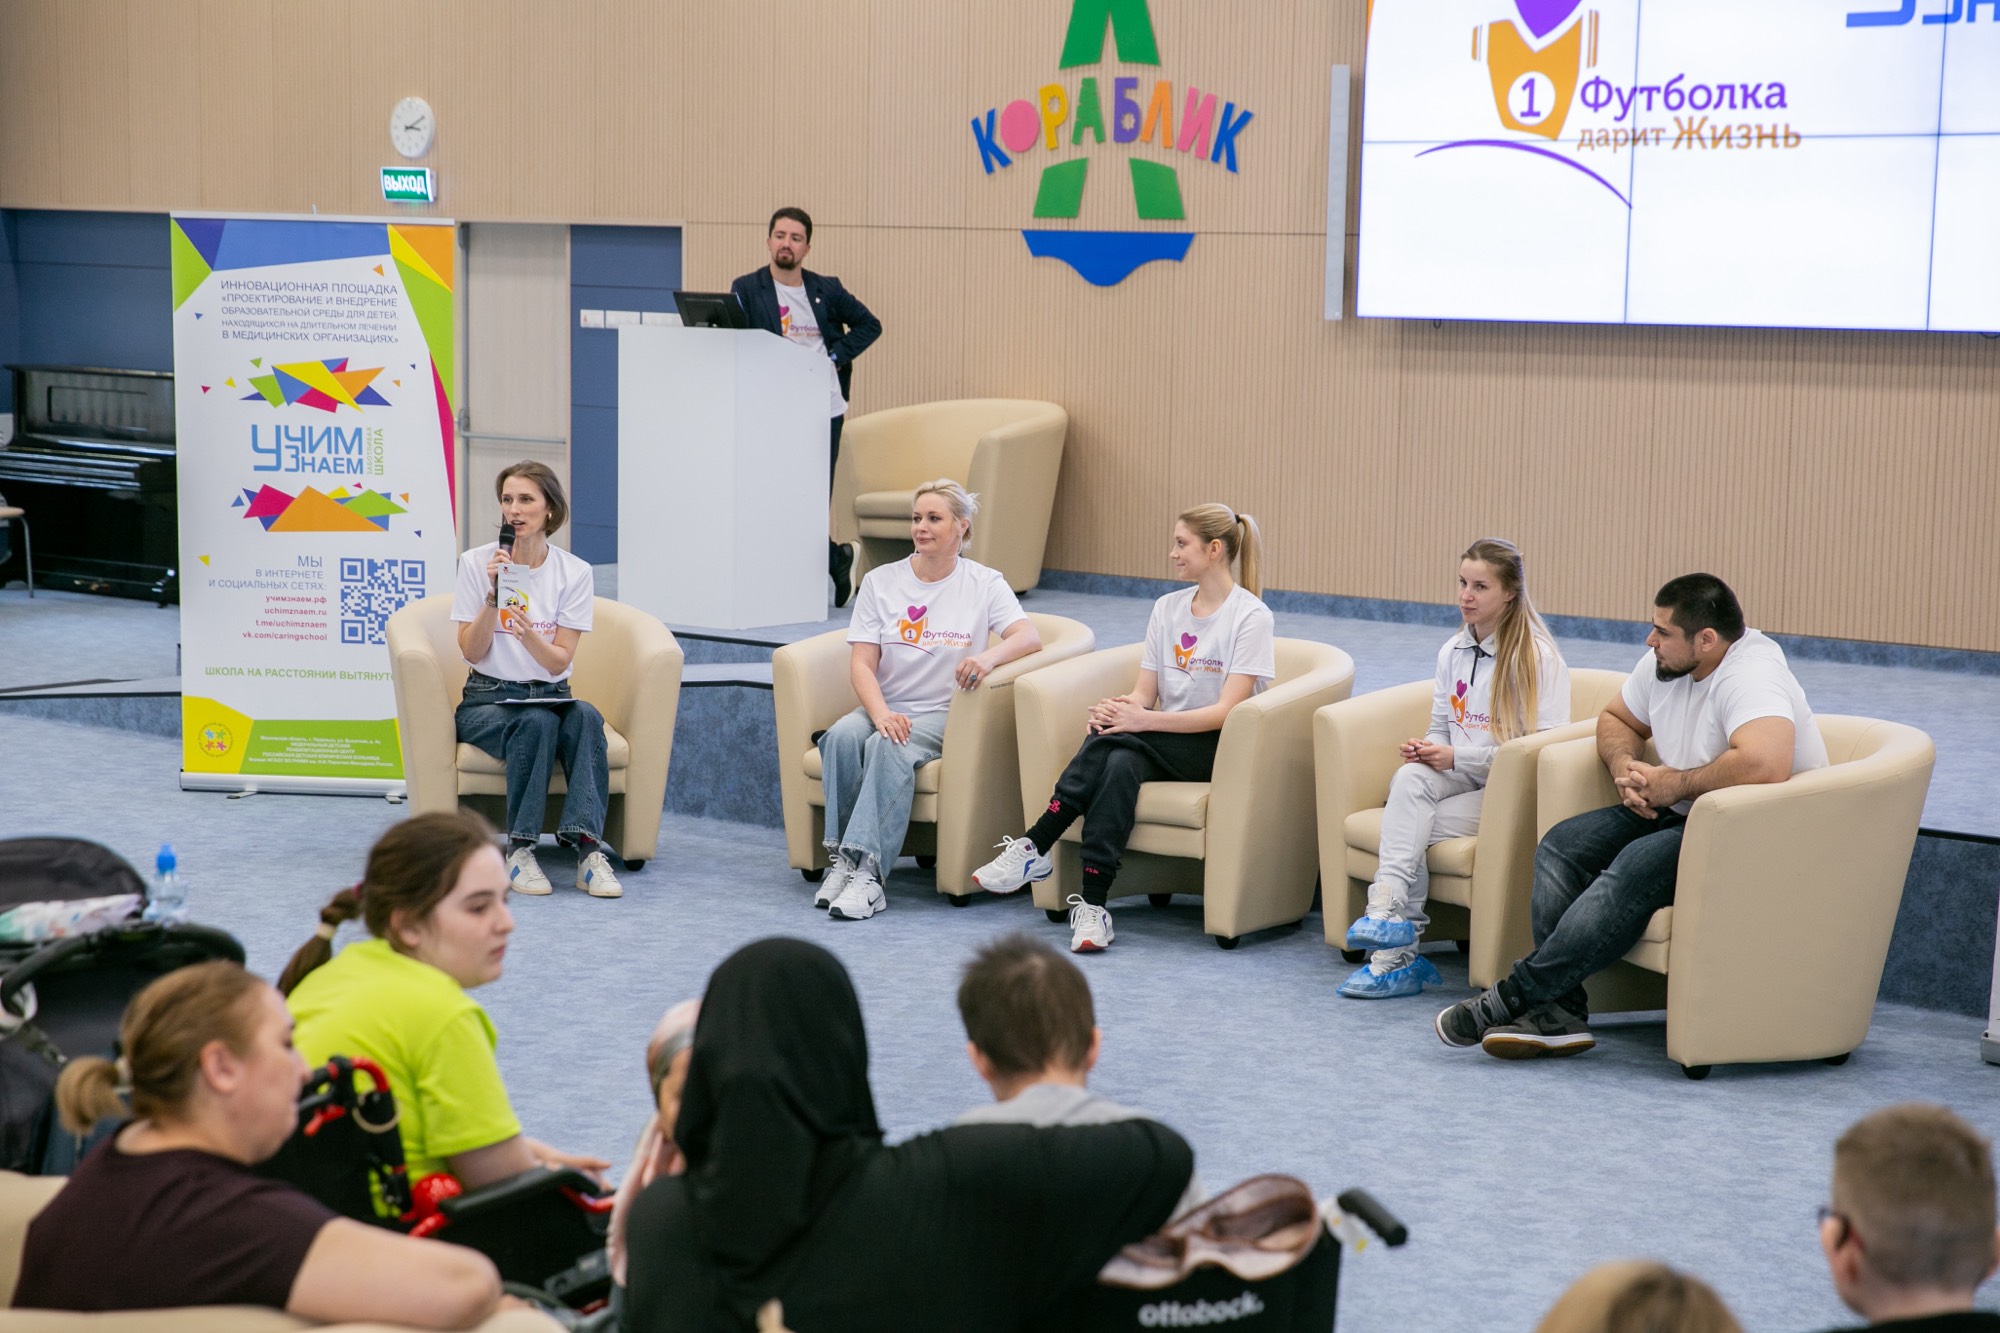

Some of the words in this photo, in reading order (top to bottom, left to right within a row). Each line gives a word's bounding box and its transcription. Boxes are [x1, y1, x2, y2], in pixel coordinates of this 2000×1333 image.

[1519, 77, 1541, 118] 1
[1580, 73, 1788, 122] Футболка
[971, 77, 1254, 175] КОРАБЛИК
[1577, 126, 1666, 154] дарит
[1672, 115, 1802, 150] Жизнь
[384, 174, 427, 195] ВЫХОД
[221, 280, 329, 293] ИННОВАЦИОННАЯ
[332, 283, 398, 295] ПЛОЩАДКА
[222, 293, 323, 305] «ПРОЕКТИРОВАНИЕ
[326, 296, 333, 304] И
[336, 297, 398, 307] ВНЕДРЕНИЕ
[221, 306, 311, 317] ОБРАЗОВАТЕЛЬНОЙ
[313, 309, 345, 318] СРЕДЫ
[347, 310, 365, 319] ДЛЯ
[221, 319, 285, 329] НАХОДЯЩИХСЯ
[300, 321, 357, 331] ДЛИТЕЛЬНОМ
[359, 323, 397, 332] ЛЕЧЕНИИ
[222, 330, 229, 339] В
[233, 330, 310, 341] МЕДИЦИНСКИХ
[313, 332, 399, 344] ОРГАНИЗАЦИЯХ»
[374, 427, 384, 476] ШКОЛА
[297, 555, 323, 568] МЫ
[255, 569, 262, 577] В
[265, 569, 324, 579] ИНТЕРНЕТЕ
[208, 579, 215, 587] И
[218, 579, 288, 590] СОЦИАЛЬНЫХ
[264, 607, 327, 616] uchimznaem.ru
[255, 619, 327, 629] t.me/uchimznaem
[242, 631, 328, 641] vk.com/caringschool
[907, 629, 914, 639] 1
[922, 630, 971, 641] Футболка
[205, 666, 244, 677] ШКОЛА
[247, 668, 262, 677] НА
[265, 668, 337, 679] РАССТОЯНИИ
